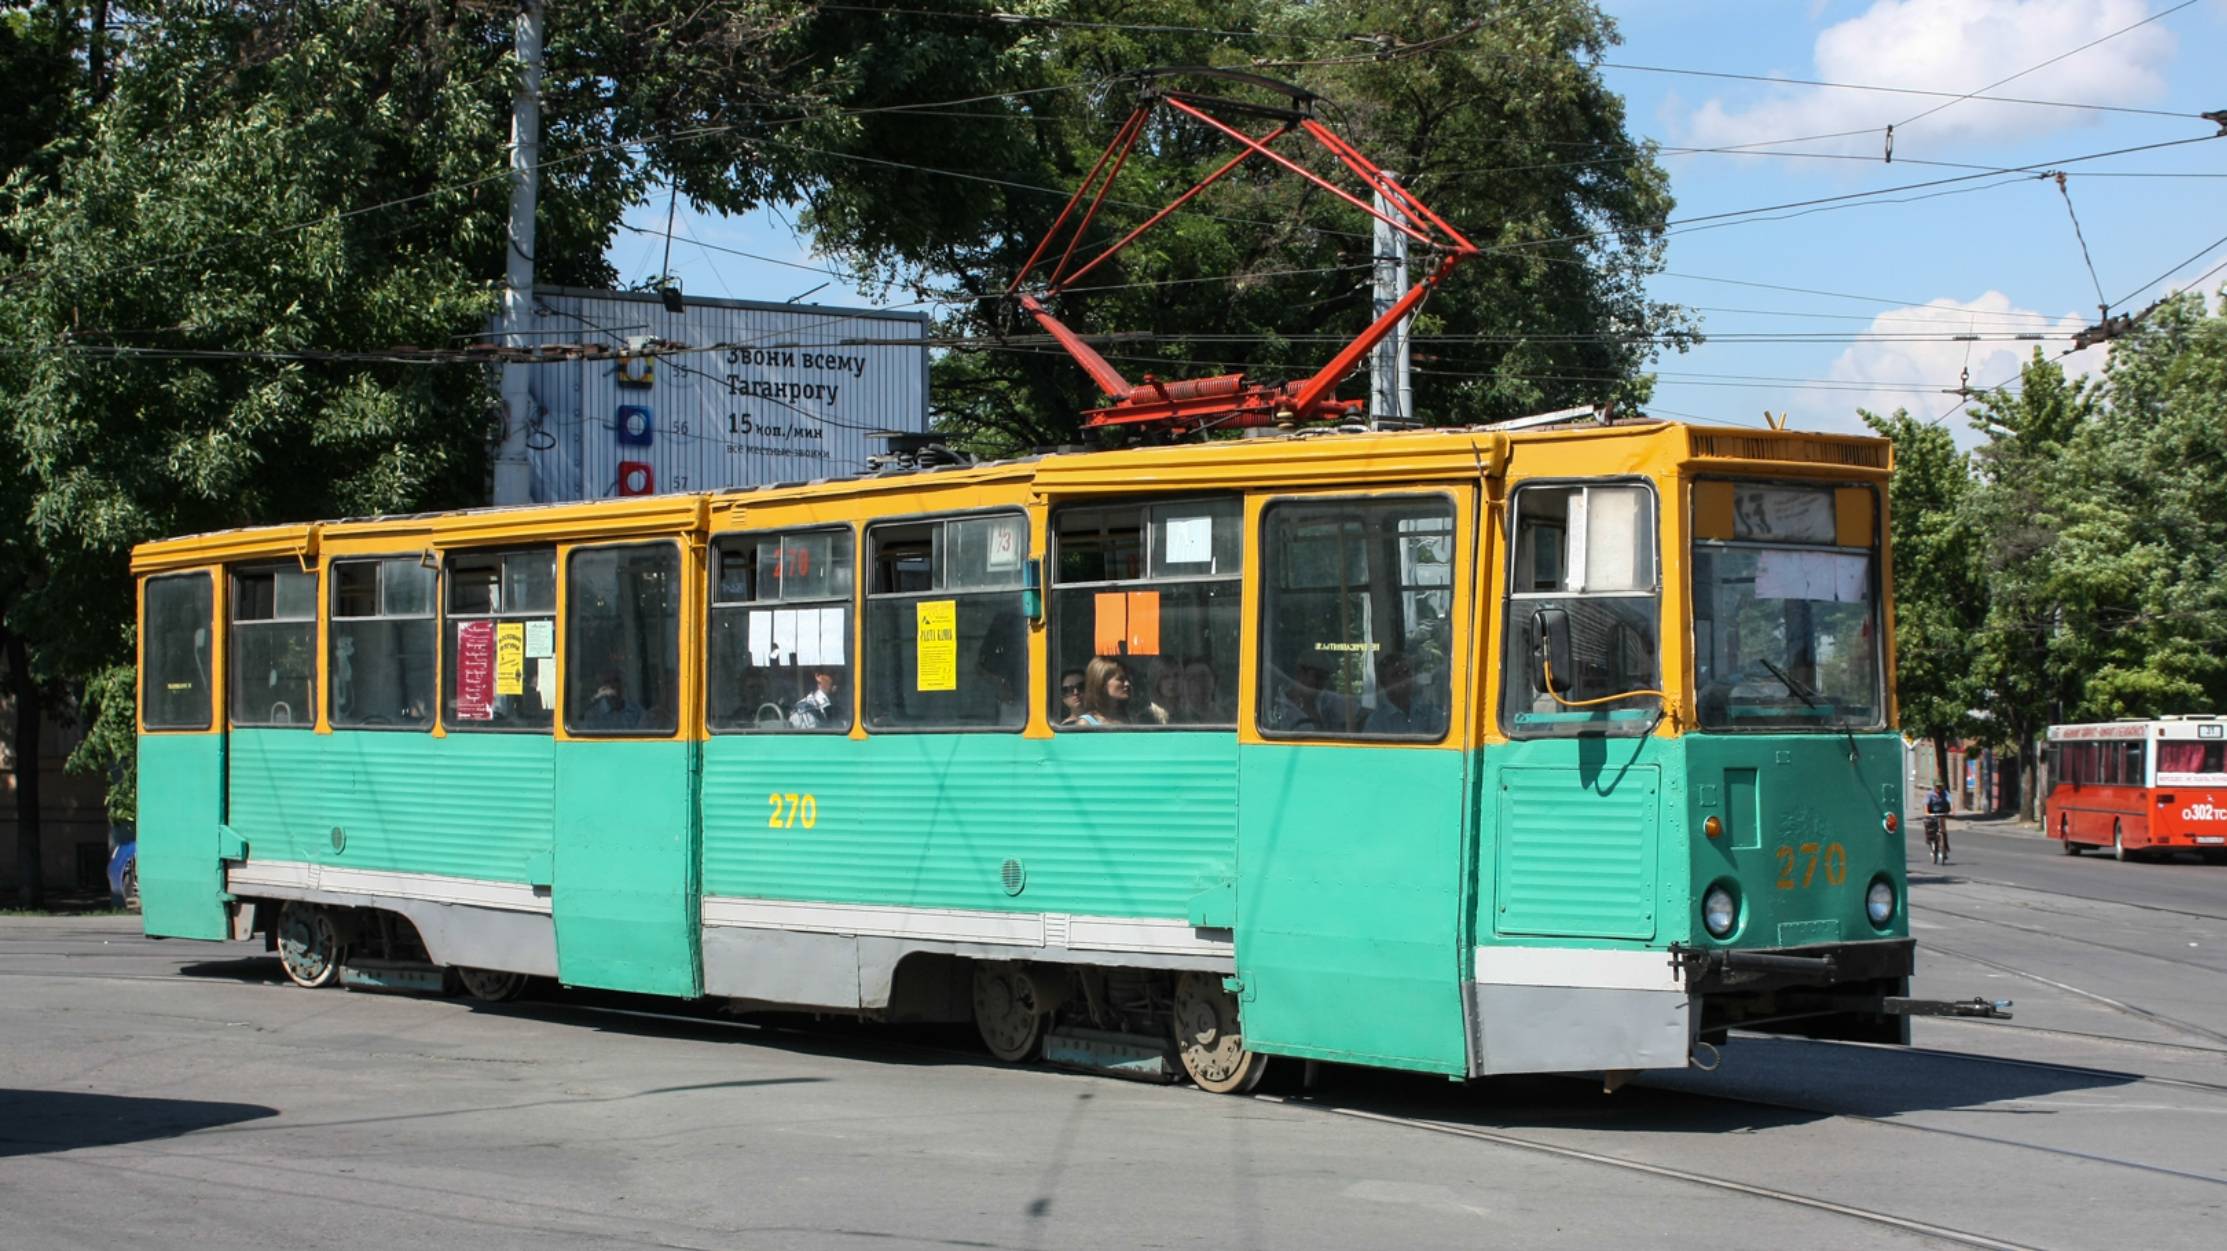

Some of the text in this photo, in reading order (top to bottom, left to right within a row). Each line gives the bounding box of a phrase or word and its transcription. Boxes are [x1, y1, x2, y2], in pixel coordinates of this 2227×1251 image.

[727, 349, 866, 378] Звони всему
[726, 374, 839, 406] Таганрогу
[673, 420, 689, 435] 56
[728, 413, 824, 441] 15 коп./мин
[673, 476, 689, 490] 57
[772, 547, 810, 577] 270
[768, 792, 817, 830] 270
[1775, 841, 1848, 890] 270
